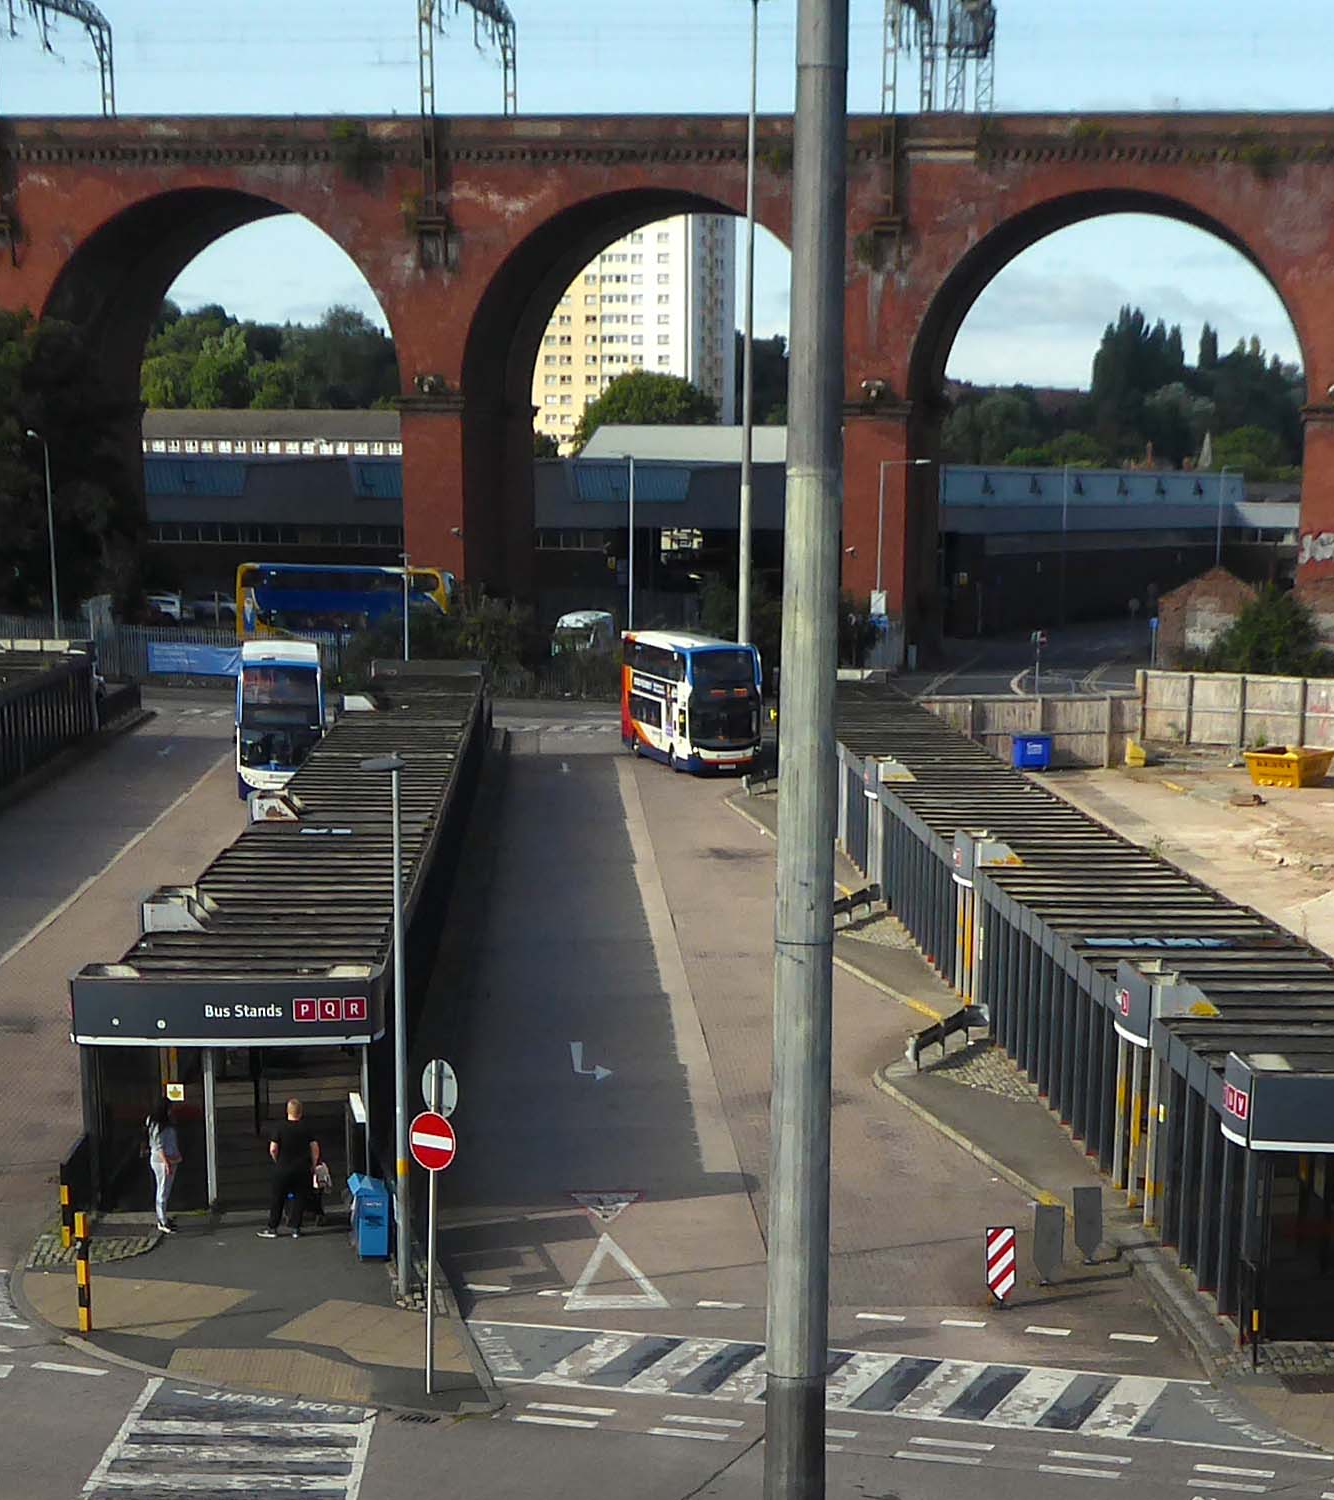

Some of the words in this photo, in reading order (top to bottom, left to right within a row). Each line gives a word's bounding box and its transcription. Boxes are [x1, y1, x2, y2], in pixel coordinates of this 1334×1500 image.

[204, 1004, 231, 1018] Bus
[234, 1003, 283, 1018] Stands
[203, 1391, 283, 1407] RIGHT
[291, 1400, 365, 1415] LOOK
